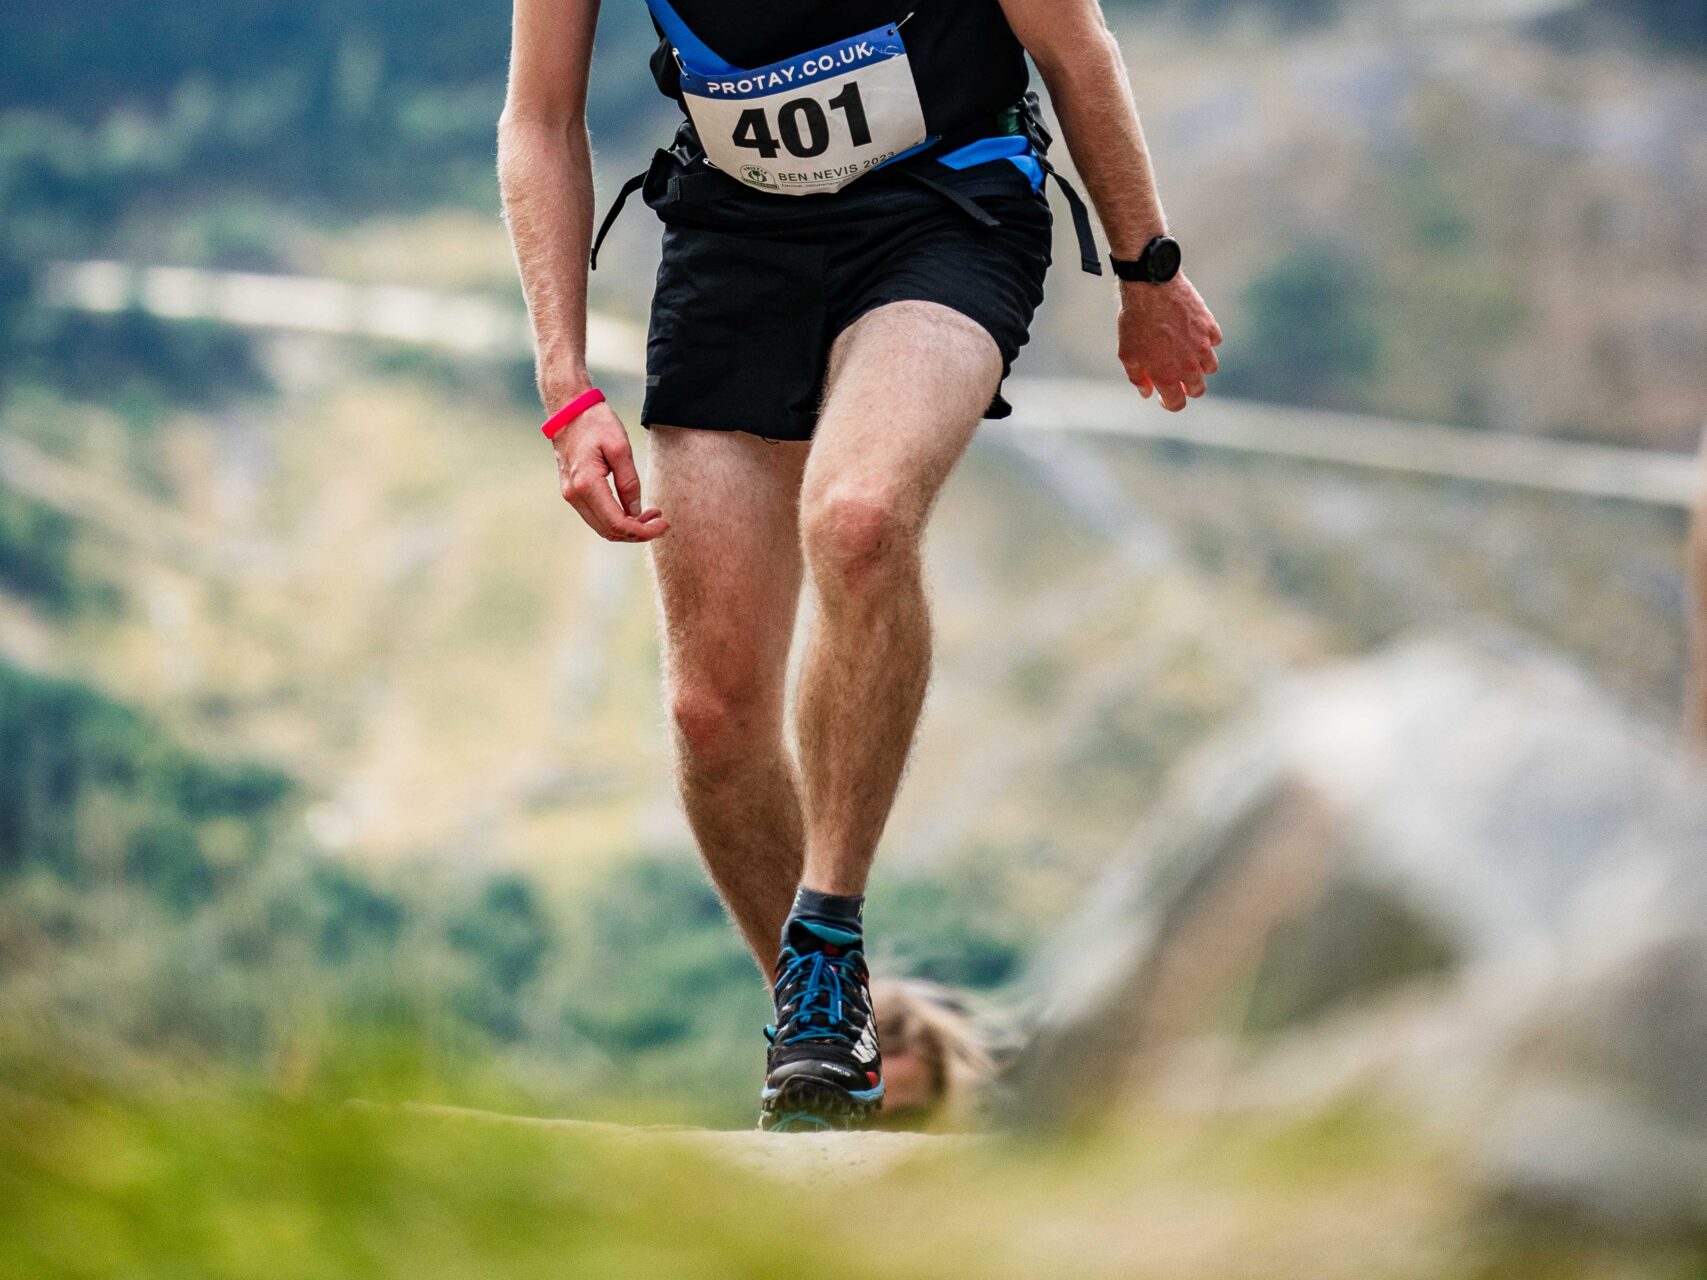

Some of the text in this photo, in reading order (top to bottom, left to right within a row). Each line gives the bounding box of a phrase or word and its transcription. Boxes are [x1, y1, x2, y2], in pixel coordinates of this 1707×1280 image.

[706, 41, 872, 95] PROTAY.CO.UK
[731, 80, 873, 160] 401
[778, 172, 808, 183] BEN
[813, 163, 858, 181] NEVIS
